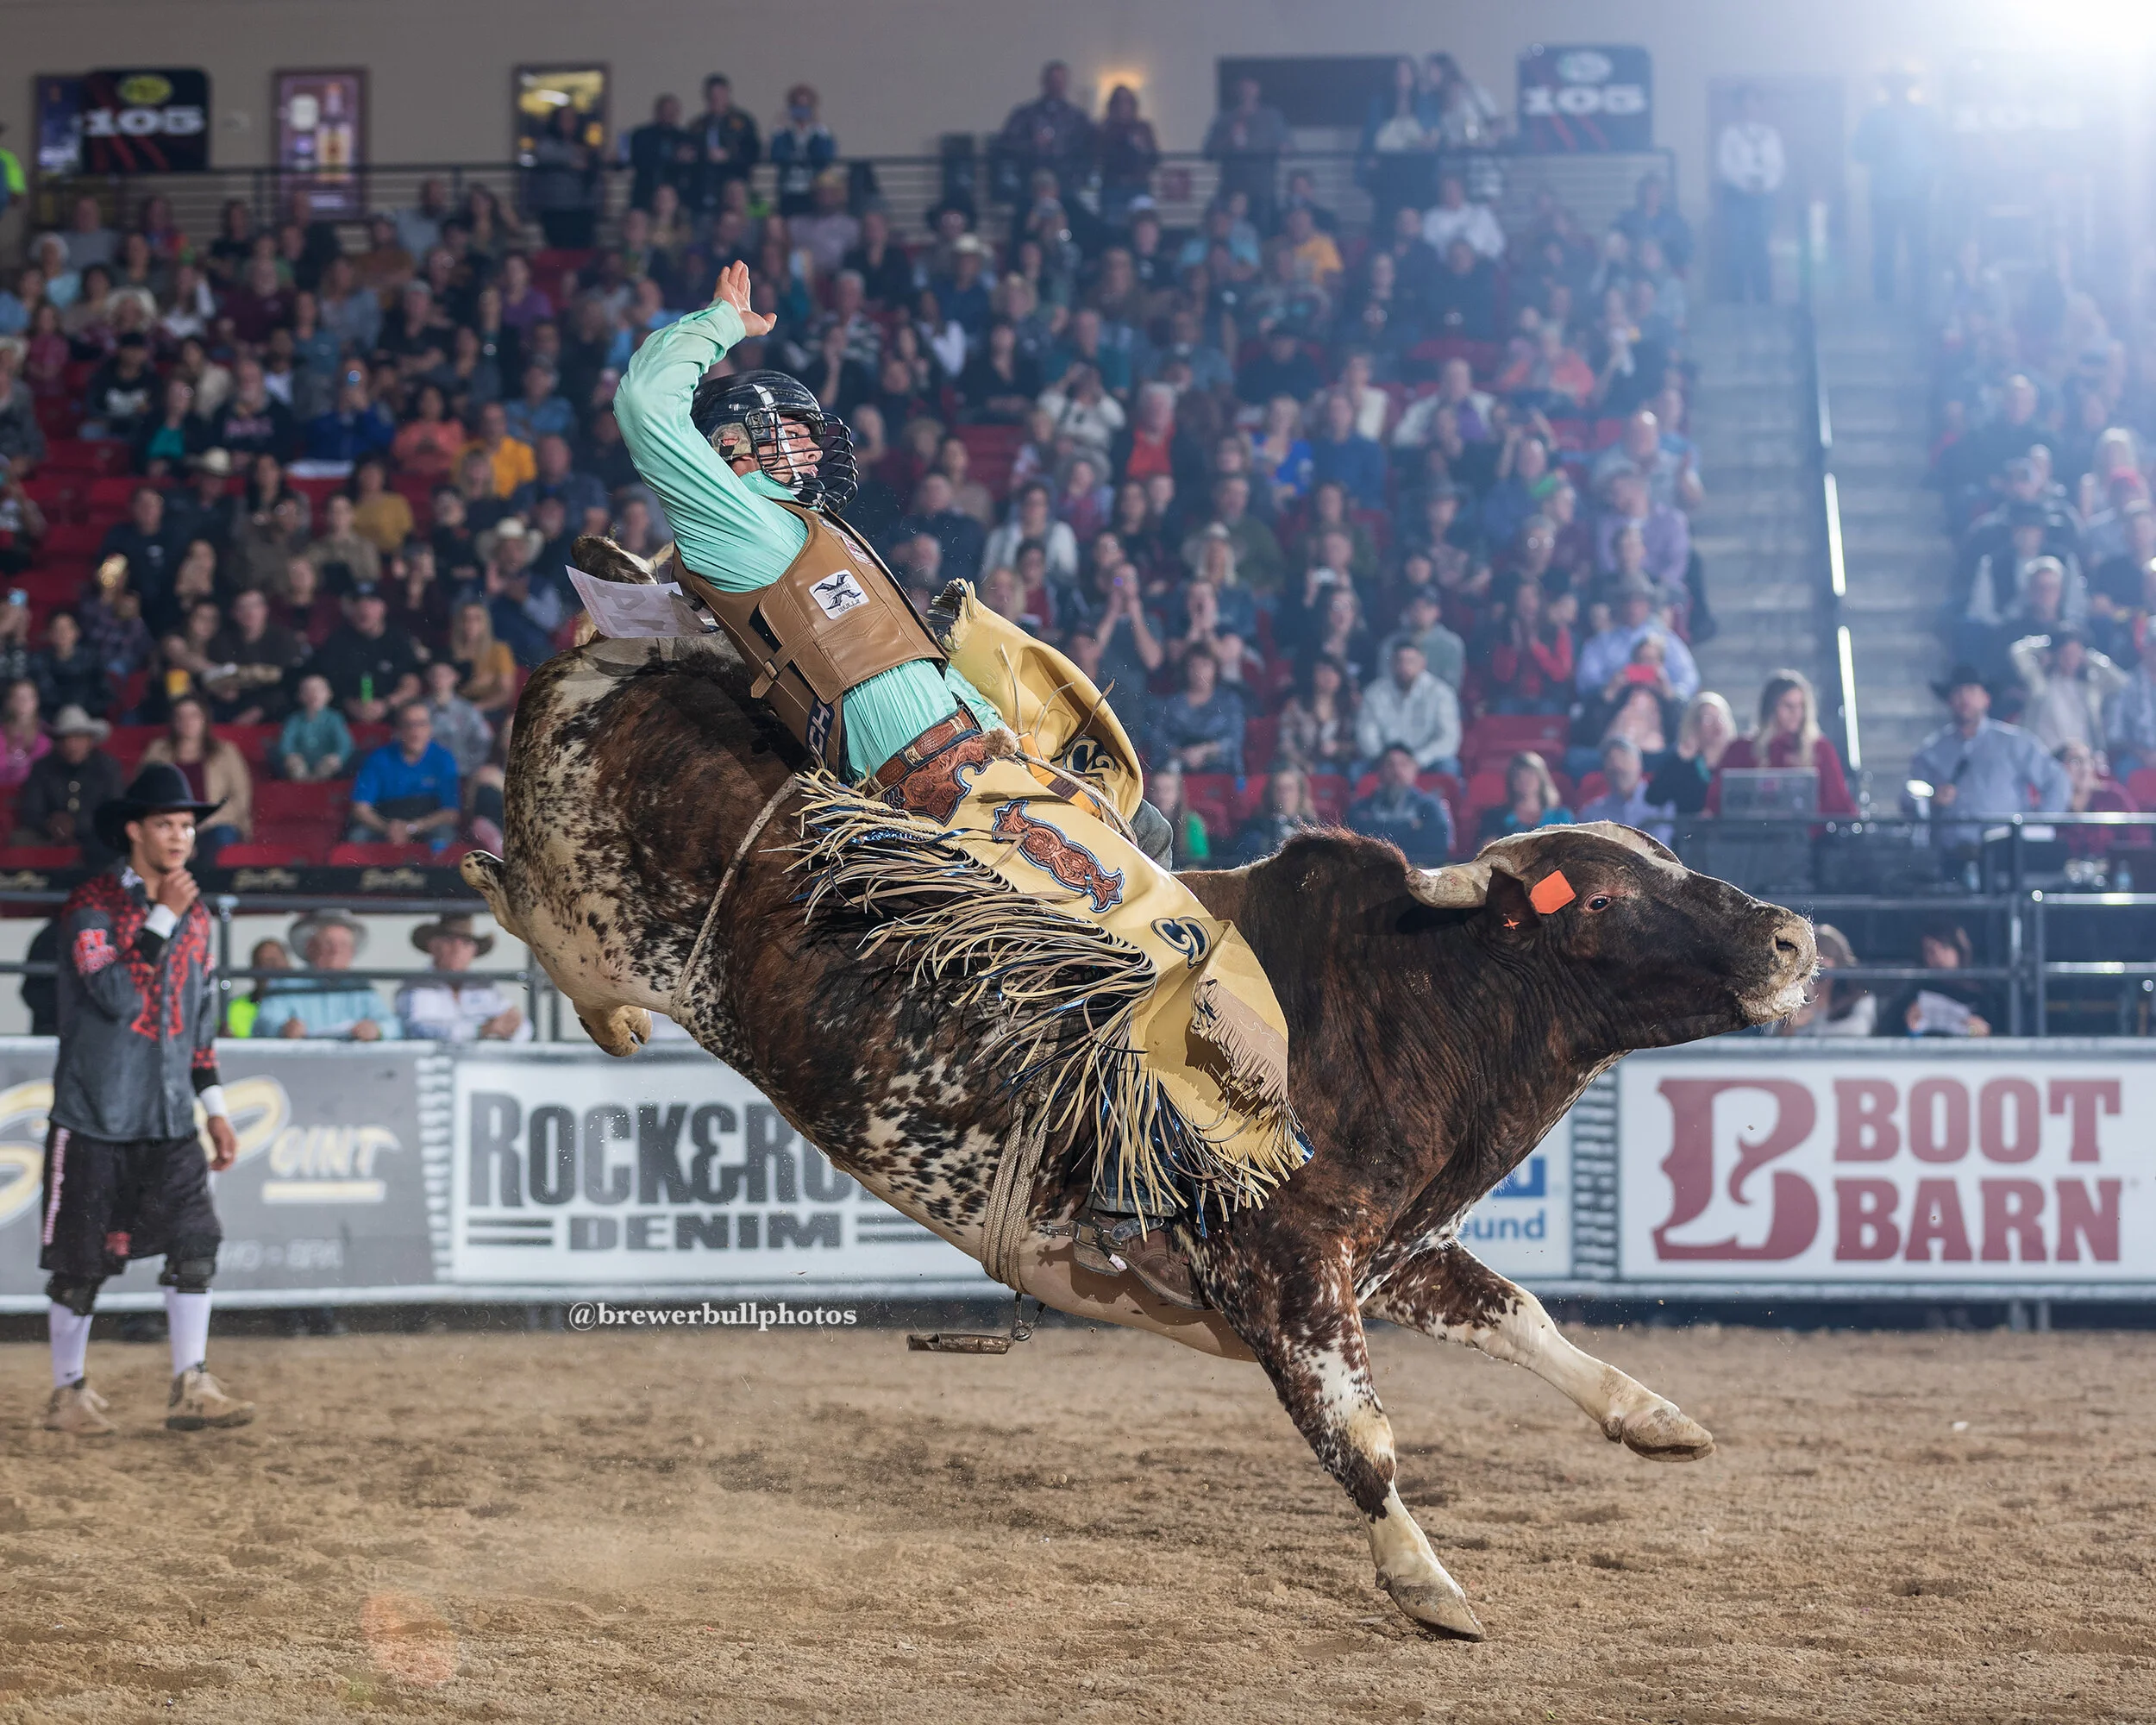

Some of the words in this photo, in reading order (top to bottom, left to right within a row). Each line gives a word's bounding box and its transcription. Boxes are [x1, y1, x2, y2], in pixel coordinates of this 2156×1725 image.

[1832, 1077, 2122, 1164] BOOT
[567, 1213, 843, 1251] DENIM
[1832, 1177, 2122, 1263] BARN
